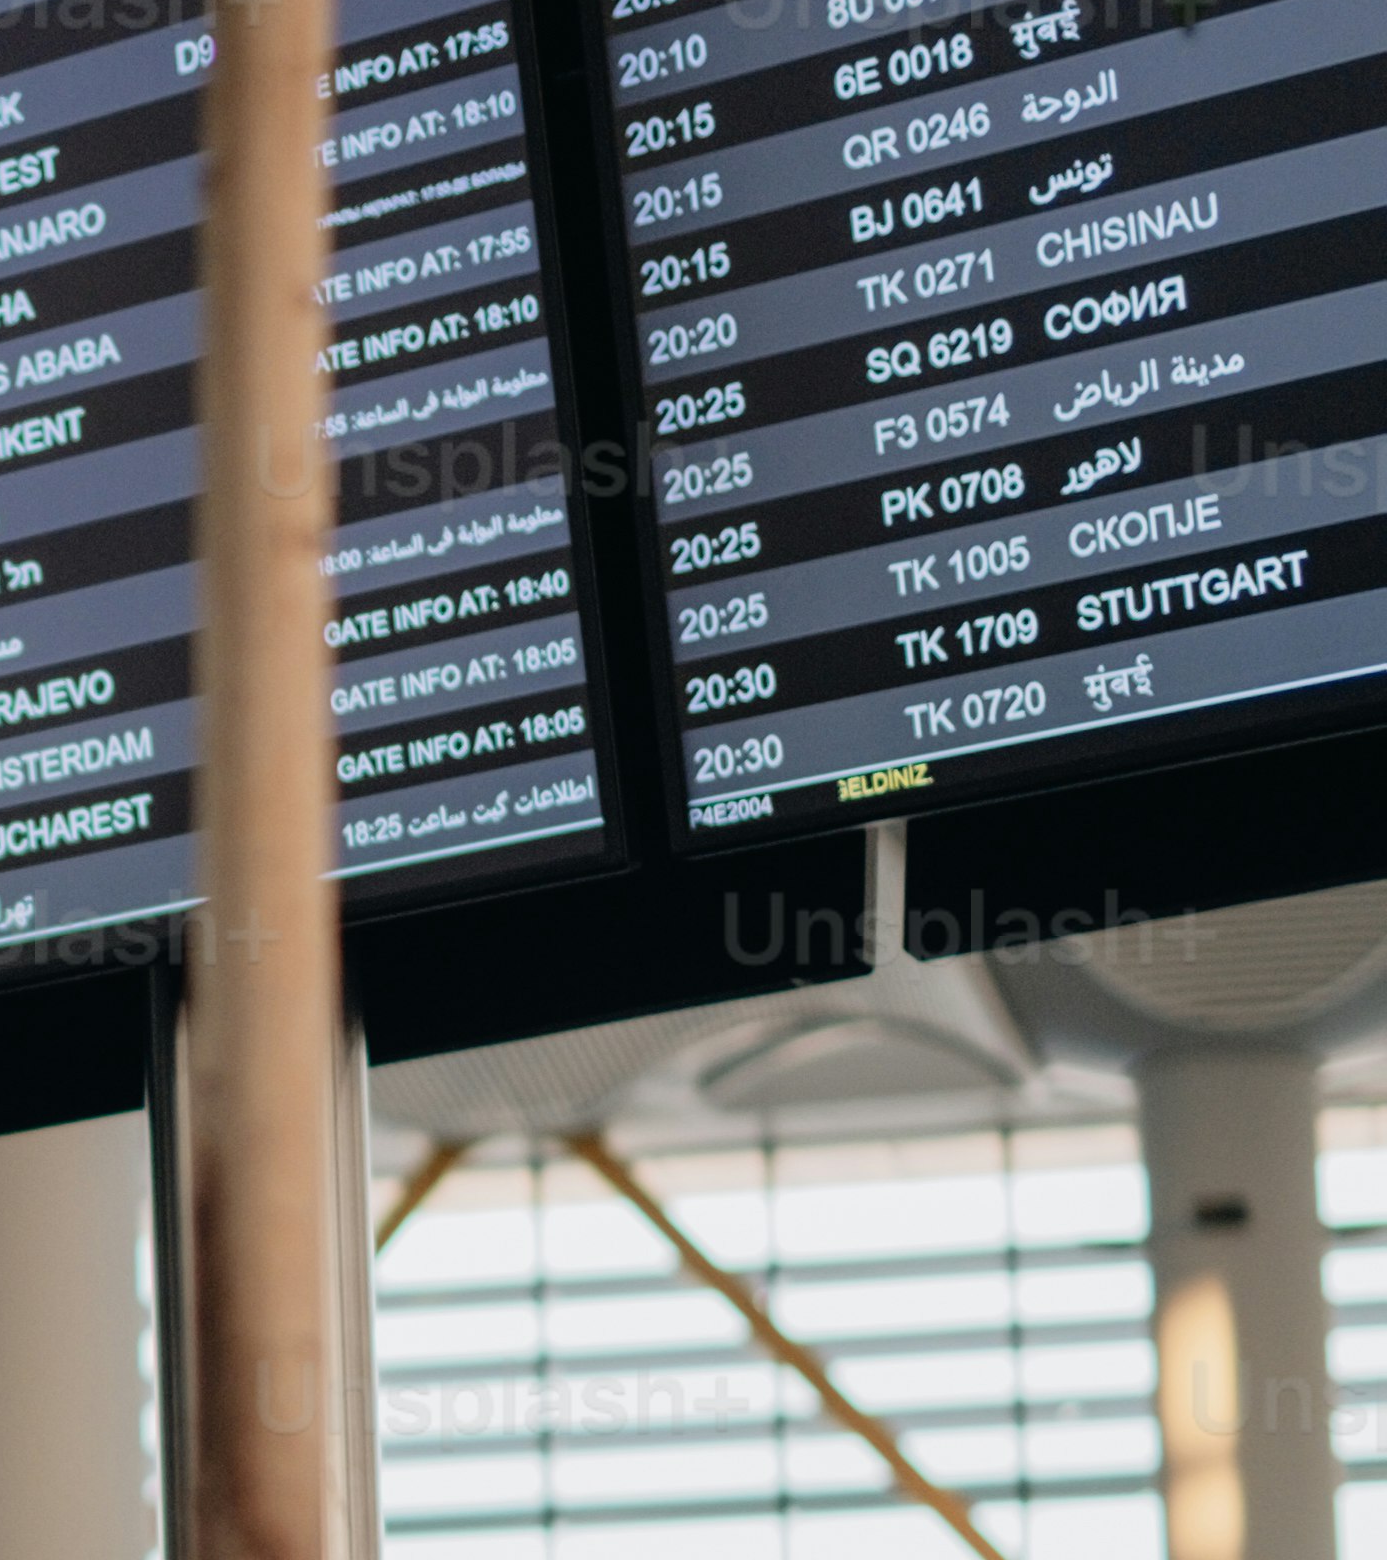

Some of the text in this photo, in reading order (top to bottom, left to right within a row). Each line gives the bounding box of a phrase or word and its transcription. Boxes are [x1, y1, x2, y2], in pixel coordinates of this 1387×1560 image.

[619, 33, 707, 87] 20:10
[626, 33, 973, 157] 20:15 6E 0018
[634, 102, 990, 225] 20:15 QR 0246
[641, 177, 982, 295] 20:15 BJ 0641
[649, 192, 1218, 364] 20:20 TK 0271 CHISINAU
[15, 334, 121, 388] ABABA
[656, 318, 1013, 434] 20:25 SQ 6219
[664, 392, 1010, 503] 20:25 F3 0574
[671, 463, 1025, 573] 20:25 PK 0708
[323, 610, 391, 649] GATE
[393, 595, 456, 631] INFO
[504, 569, 570, 606] 18:40
[679, 535, 1030, 643] 20:25 TK 1005
[686, 550, 1308, 713] 20:30 TK 1709 STUTTGART
[512, 637, 577, 674] 18:05
[694, 681, 1046, 783] 20:30 TK 0720
